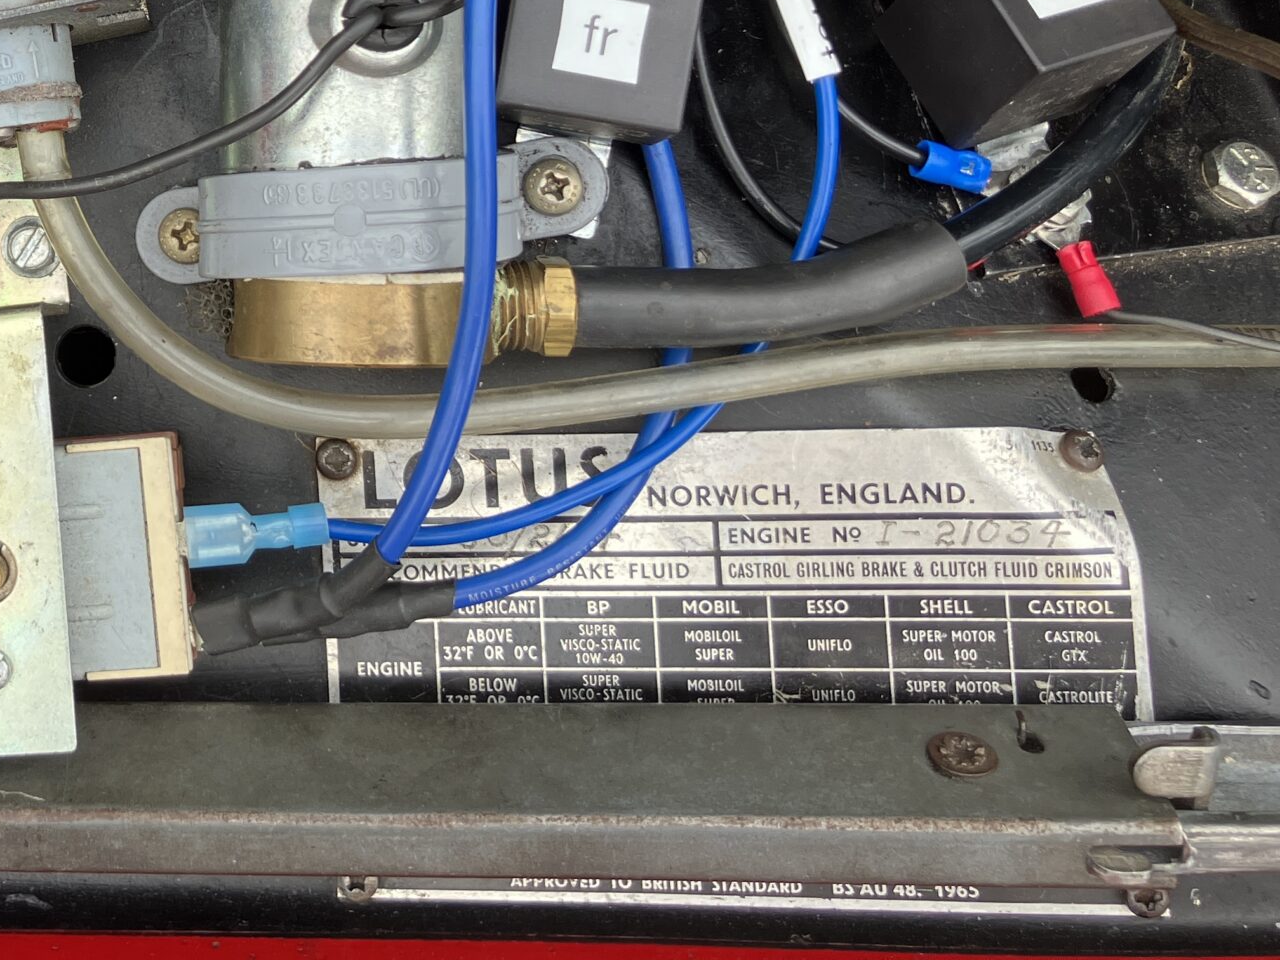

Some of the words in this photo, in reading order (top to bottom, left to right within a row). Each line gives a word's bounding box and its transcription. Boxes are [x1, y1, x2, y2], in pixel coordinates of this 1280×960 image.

[584, 15, 619, 56] fr
[362, 446, 609, 510] LOTUS
[647, 483, 800, 510] NORWICH,
[820, 482, 975, 506] ENGLAND.
[728, 526, 811, 545] ENGINE
[628, 562, 690, 580] FLUID
[728, 561, 790, 580] CASTROL
[796, 561, 855, 580] GIRLING
[861, 561, 908, 579] BRAKE
[913, 561, 924, 578] &
[930, 561, 988, 579] CLUTCH
[994, 561, 1038, 579] FLUID
[1044, 560, 1113, 579] CRIMSON
[457, 599, 537, 615] LUBRICANT
[586, 599, 611, 615] BP
[682, 599, 740, 615] MOBIL
[806, 599, 850, 615] ESSO
[919, 599, 973, 615] SHELL
[1027, 599, 1115, 616] CASTROL
[466, 628, 514, 644] ABOVE
[577, 623, 617, 638] SUPER
[684, 629, 742, 644] MOBILOIL
[901, 629, 943, 643] SUPER
[950, 629, 996, 643] MOTOR
[1044, 629, 1102, 644] CASTROL
[442, 644, 475, 661] 32°F
[483, 644, 505, 660] OR
[513, 644, 539, 660] 0°C
[560, 637, 642, 652] VISCO-STATIC
[807, 638, 853, 653] UNIFLO
[574, 651, 625, 665] 10W-40
[694, 647, 735, 662] SUPER
[922, 648, 946, 662] OIL
[954, 648, 978, 661] 100
[1061, 648, 1088, 662] GTX
[356, 661, 423, 677] ENGINE
[468, 677, 518, 693] BELOW
[581, 675, 621, 688] SUPER
[687, 678, 745, 693] MOBILOIL
[905, 679, 946, 694] SUPER
[955, 679, 1002, 695] MOTOR
[559, 687, 644, 702] VISCO-STATIC
[811, 688, 856, 703] UNIFLO
[1038, 690, 1114, 705] CASTROLITE
[509, 877, 601, 889] APPROVED
[641, 878, 703, 892] BRITISH
[711, 880, 803, 894] STANDARD
